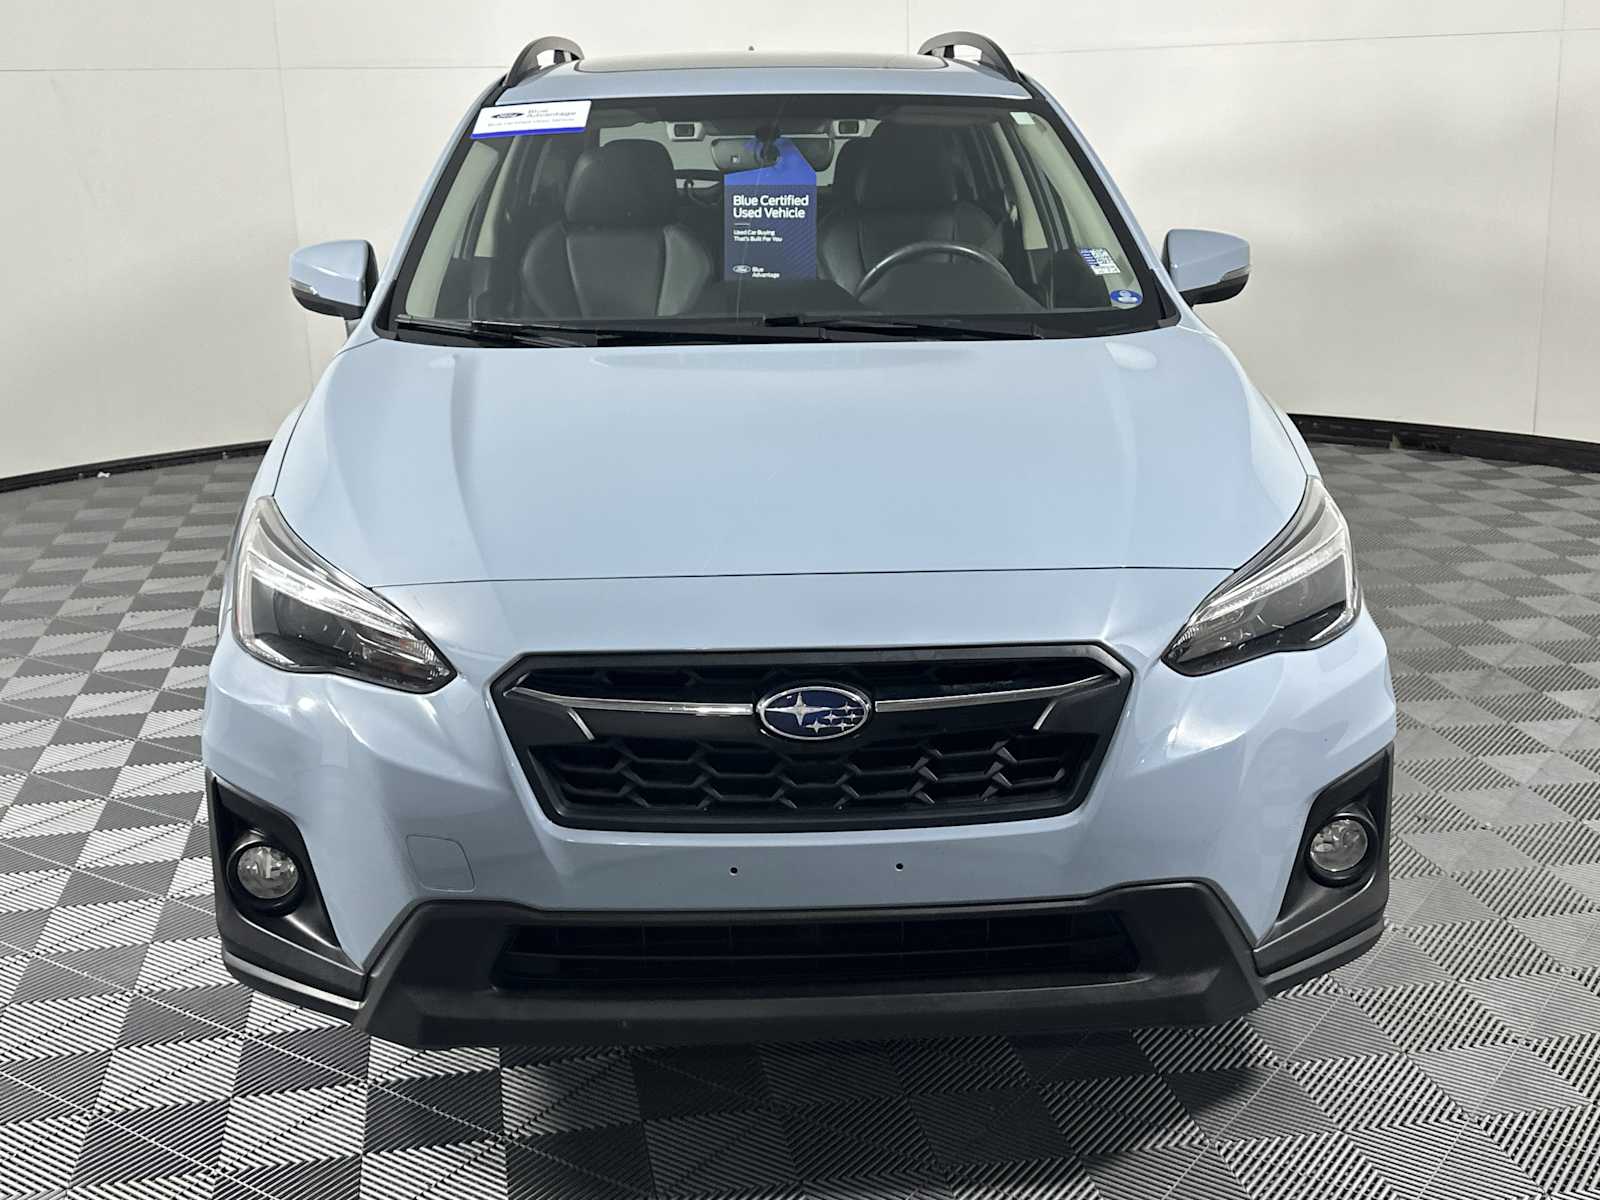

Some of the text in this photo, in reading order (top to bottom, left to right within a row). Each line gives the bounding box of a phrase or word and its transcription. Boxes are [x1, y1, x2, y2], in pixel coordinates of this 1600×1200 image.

[733, 194, 809, 206] Blue Certified
[733, 207, 806, 218] Used Vehicle
